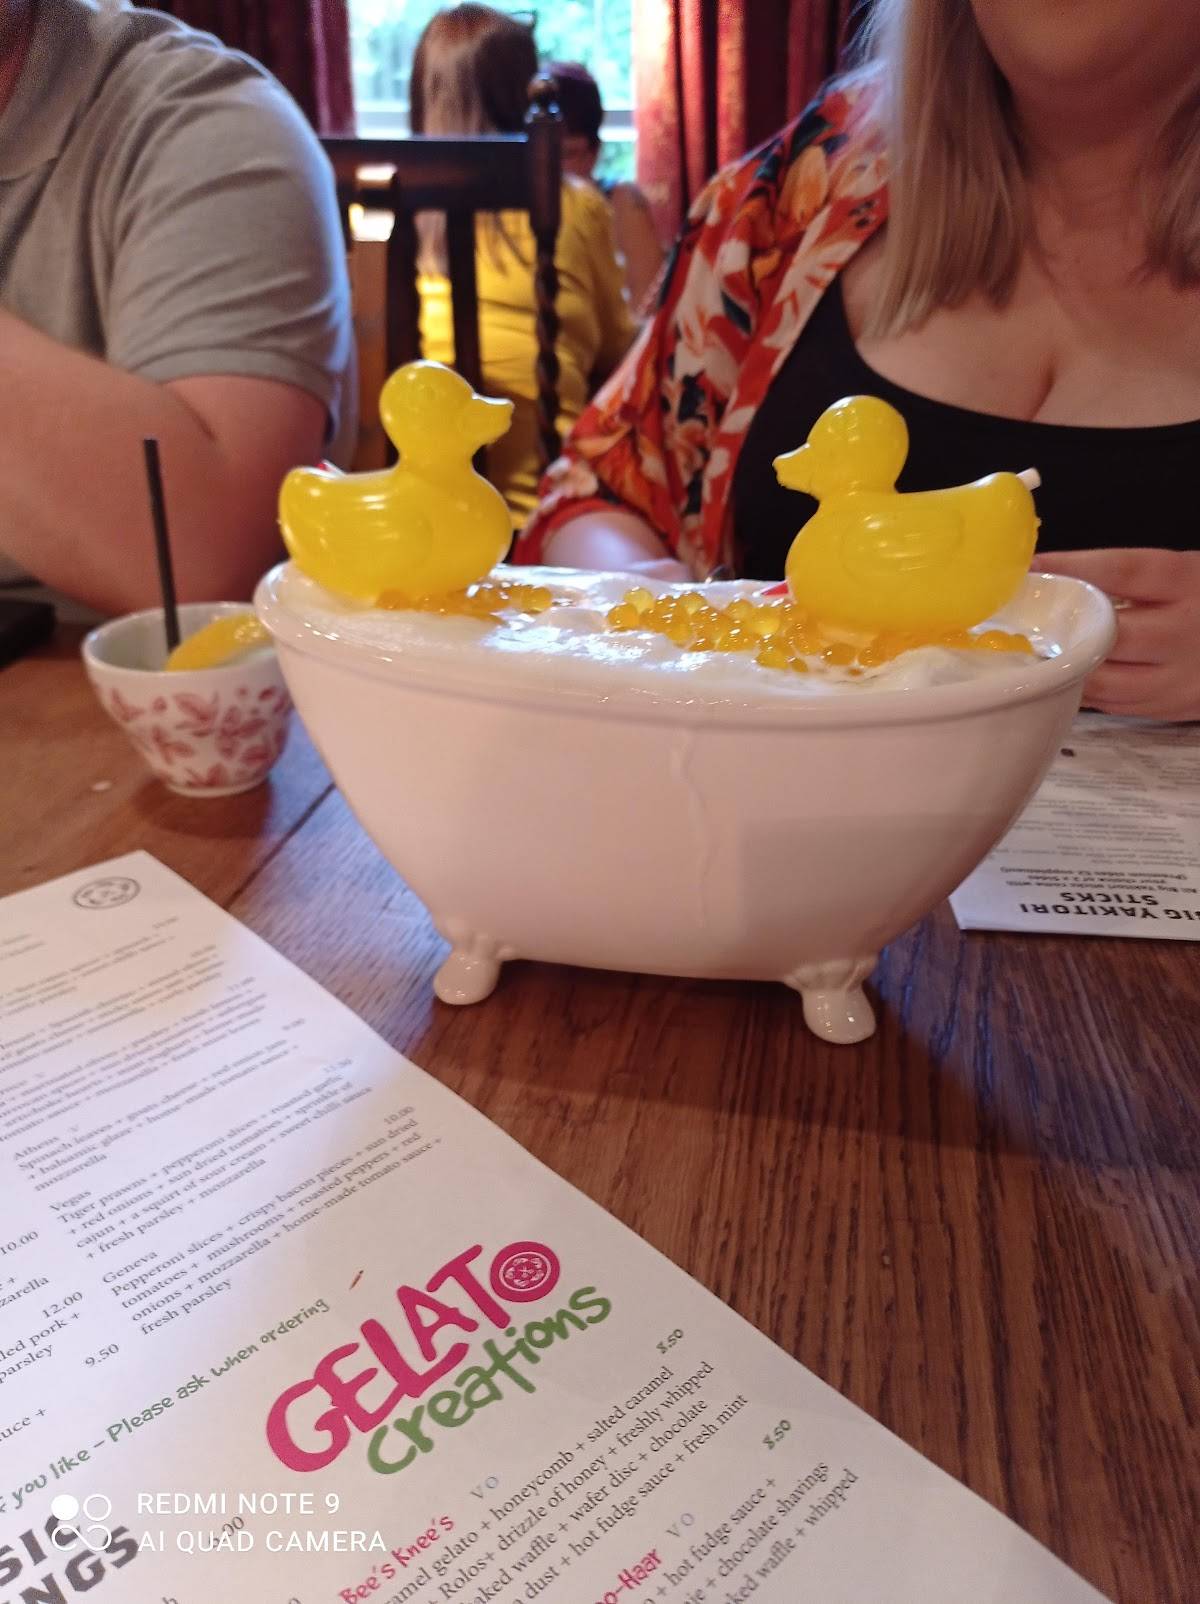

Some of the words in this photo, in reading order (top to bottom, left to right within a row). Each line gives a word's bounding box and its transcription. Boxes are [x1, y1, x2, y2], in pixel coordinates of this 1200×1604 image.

[1020, 903, 1158, 920] YAKITORI
[1060, 892, 1159, 906] STICKS
[0, 1231, 39, 1255] 10.00
[49, 1190, 92, 1213] Vegas
[98, 1230, 135, 1253] fresh
[136, 1204, 185, 1235] parsley
[199, 1158, 267, 1199] mozzarella
[110, 1252, 186, 1297] Pepperoni
[187, 1232, 224, 1255] slices
[238, 1200, 276, 1226] crispy
[276, 1177, 316, 1202] bacon
[315, 1156, 353, 1182] pieces
[364, 1137, 386, 1152] sun
[387, 1118, 419, 1139] dried
[121, 1269, 188, 1309] tomatoes
[206, 1213, 285, 1262] mushrooms
[298, 1176, 343, 1207] roasted
[343, 1151, 390, 1182] peppers
[401, 1132, 421, 1147] red
[131, 1289, 183, 1322] onions
[198, 1237, 272, 1284] mozzarella
[282, 1184, 357, 1233] home-made
[357, 1162, 401, 1188] tomato
[402, 1143, 433, 1163] sauce
[42, 1291, 83, 1318] 12.00
[102, 1250, 158, 1284] Geneva
[140, 1309, 180, 1335] fresh
[180, 1279, 232, 1315] parsley
[0, 1339, 26, 1362] led
[29, 1319, 67, 1346] pork
[85, 1343, 119, 1366] 9.50
[266, 1241, 560, 1473] GELATO
[367, 1286, 612, 1475] creations
[656, 1328, 684, 1354] 8.50
[0, 1416, 31, 1442] uce
[12, 1474, 47, 1510] you
[50, 1449, 91, 1479] like
[106, 1396, 174, 1442] Please
[176, 1374, 210, 1399] ask
[210, 1344, 259, 1377] when
[260, 1298, 330, 1344] ordering
[763, 1419, 791, 1450] 8.50
[384, 1566, 432, 1604] amel
[432, 1531, 479, 1577] gelato
[489, 1450, 575, 1522] honeycomb
[587, 1405, 626, 1442] salted
[625, 1365, 674, 1410] caramel
[497, 1505, 548, 1551] drizzle
[548, 1487, 565, 1508] of
[560, 1455, 608, 1495] honey
[616, 1407, 664, 1447] freshly
[660, 1360, 715, 1409] whipped
[525, 1566, 560, 1599] dust
[568, 1530, 600, 1556] hot
[596, 1495, 639, 1533] fudge
[637, 1462, 676, 1497] sauce
[683, 1423, 719, 1455] fresh
[716, 1394, 748, 1425] mint
[470, 1568, 513, 1604] aked
[511, 1532, 558, 1573] waffle
[569, 1486, 611, 1522] wafer
[609, 1461, 639, 1488] disc
[650, 1399, 708, 1452] chocolate
[663, 1559, 695, 1587] hot
[690, 1522, 732, 1562] fudge
[731, 1488, 767, 1524] sauce
[718, 1515, 779, 1577] chocolate
[777, 1462, 829, 1516] shavings
[724, 1574, 760, 1604] ked
[756, 1537, 796, 1579] waffle
[805, 1468, 858, 1526] whipped
[0, 1526, 139, 1604] NGS
[338, 1563, 396, 1604] Bee's
[391, 1516, 454, 1568] Knee's
[595, 1548, 662, 1604] o-Haar
